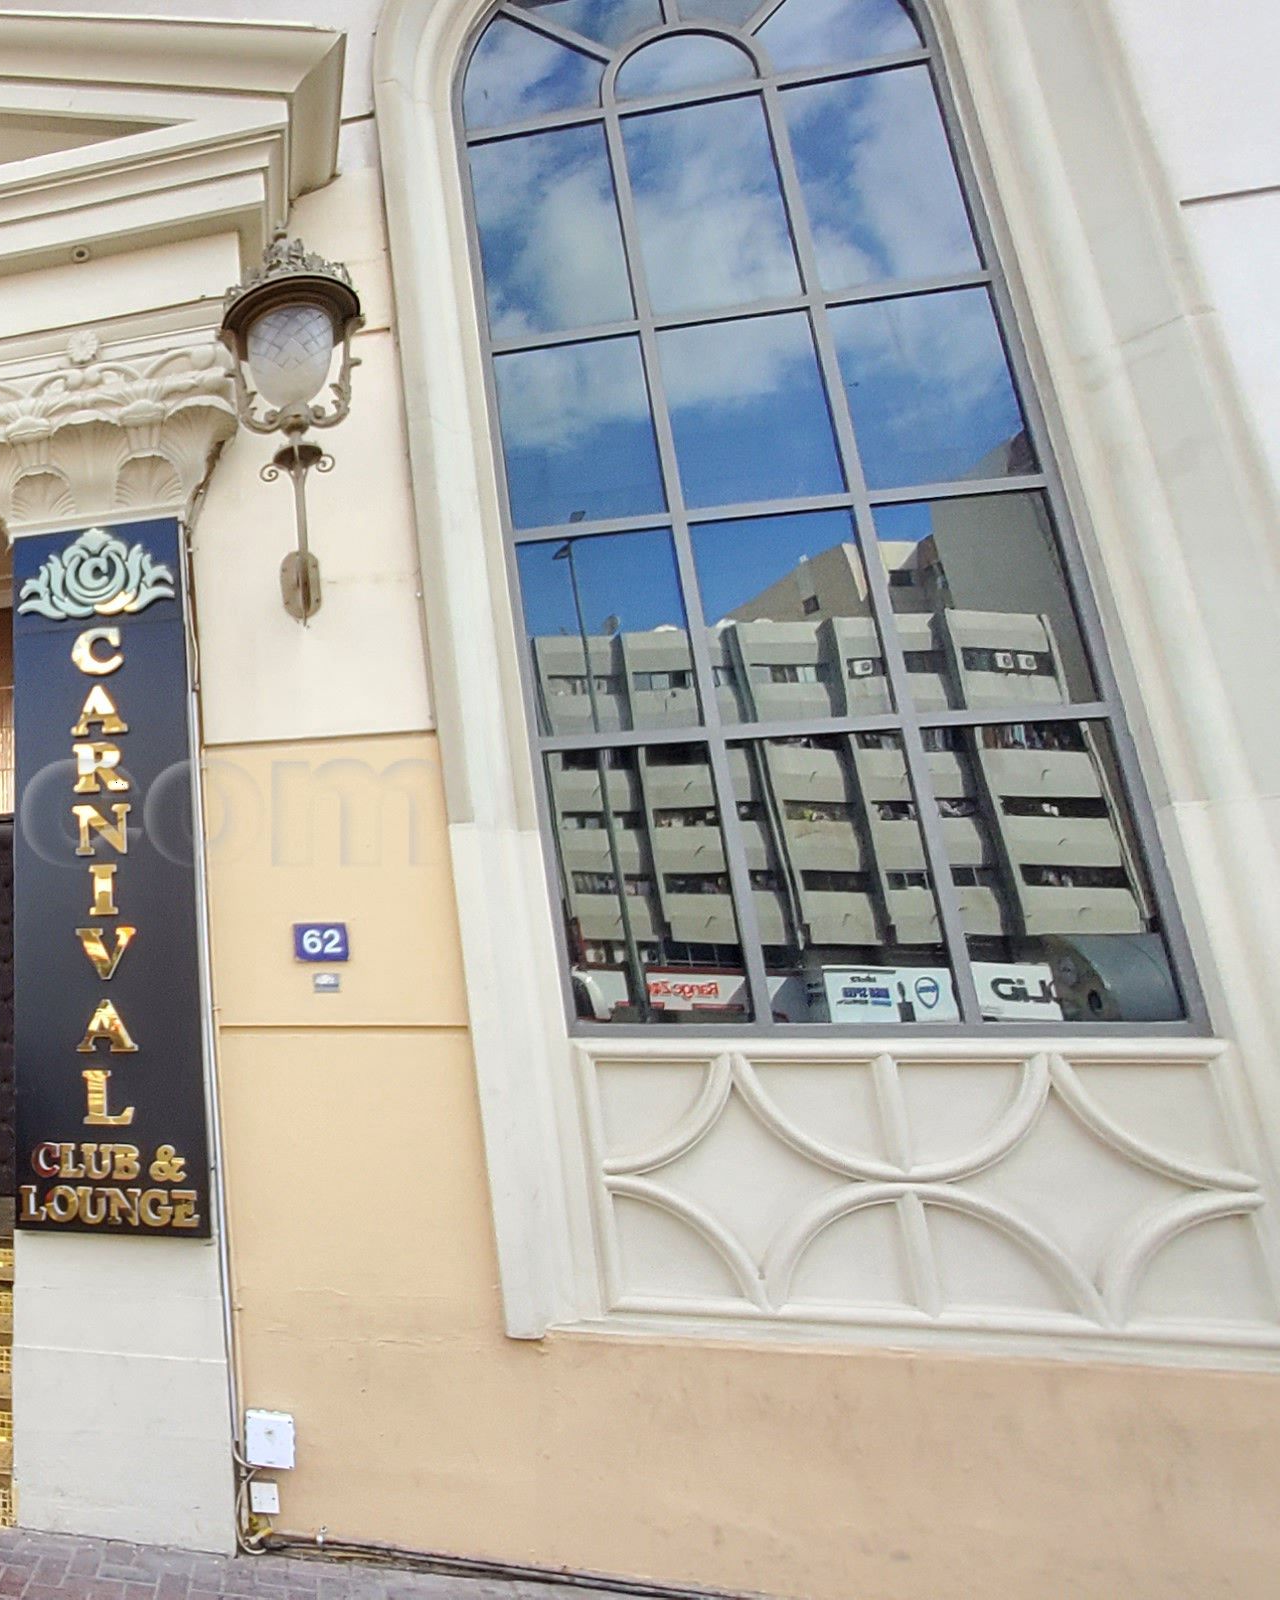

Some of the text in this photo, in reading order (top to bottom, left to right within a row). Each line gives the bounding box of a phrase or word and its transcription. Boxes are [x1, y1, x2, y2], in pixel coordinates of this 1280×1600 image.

[70, 626, 139, 1126] CARNIVAL
[302, 928, 343, 954] 62
[31, 1142, 187, 1183] CLUB &
[20, 1184, 201, 1228] LOUNGE
